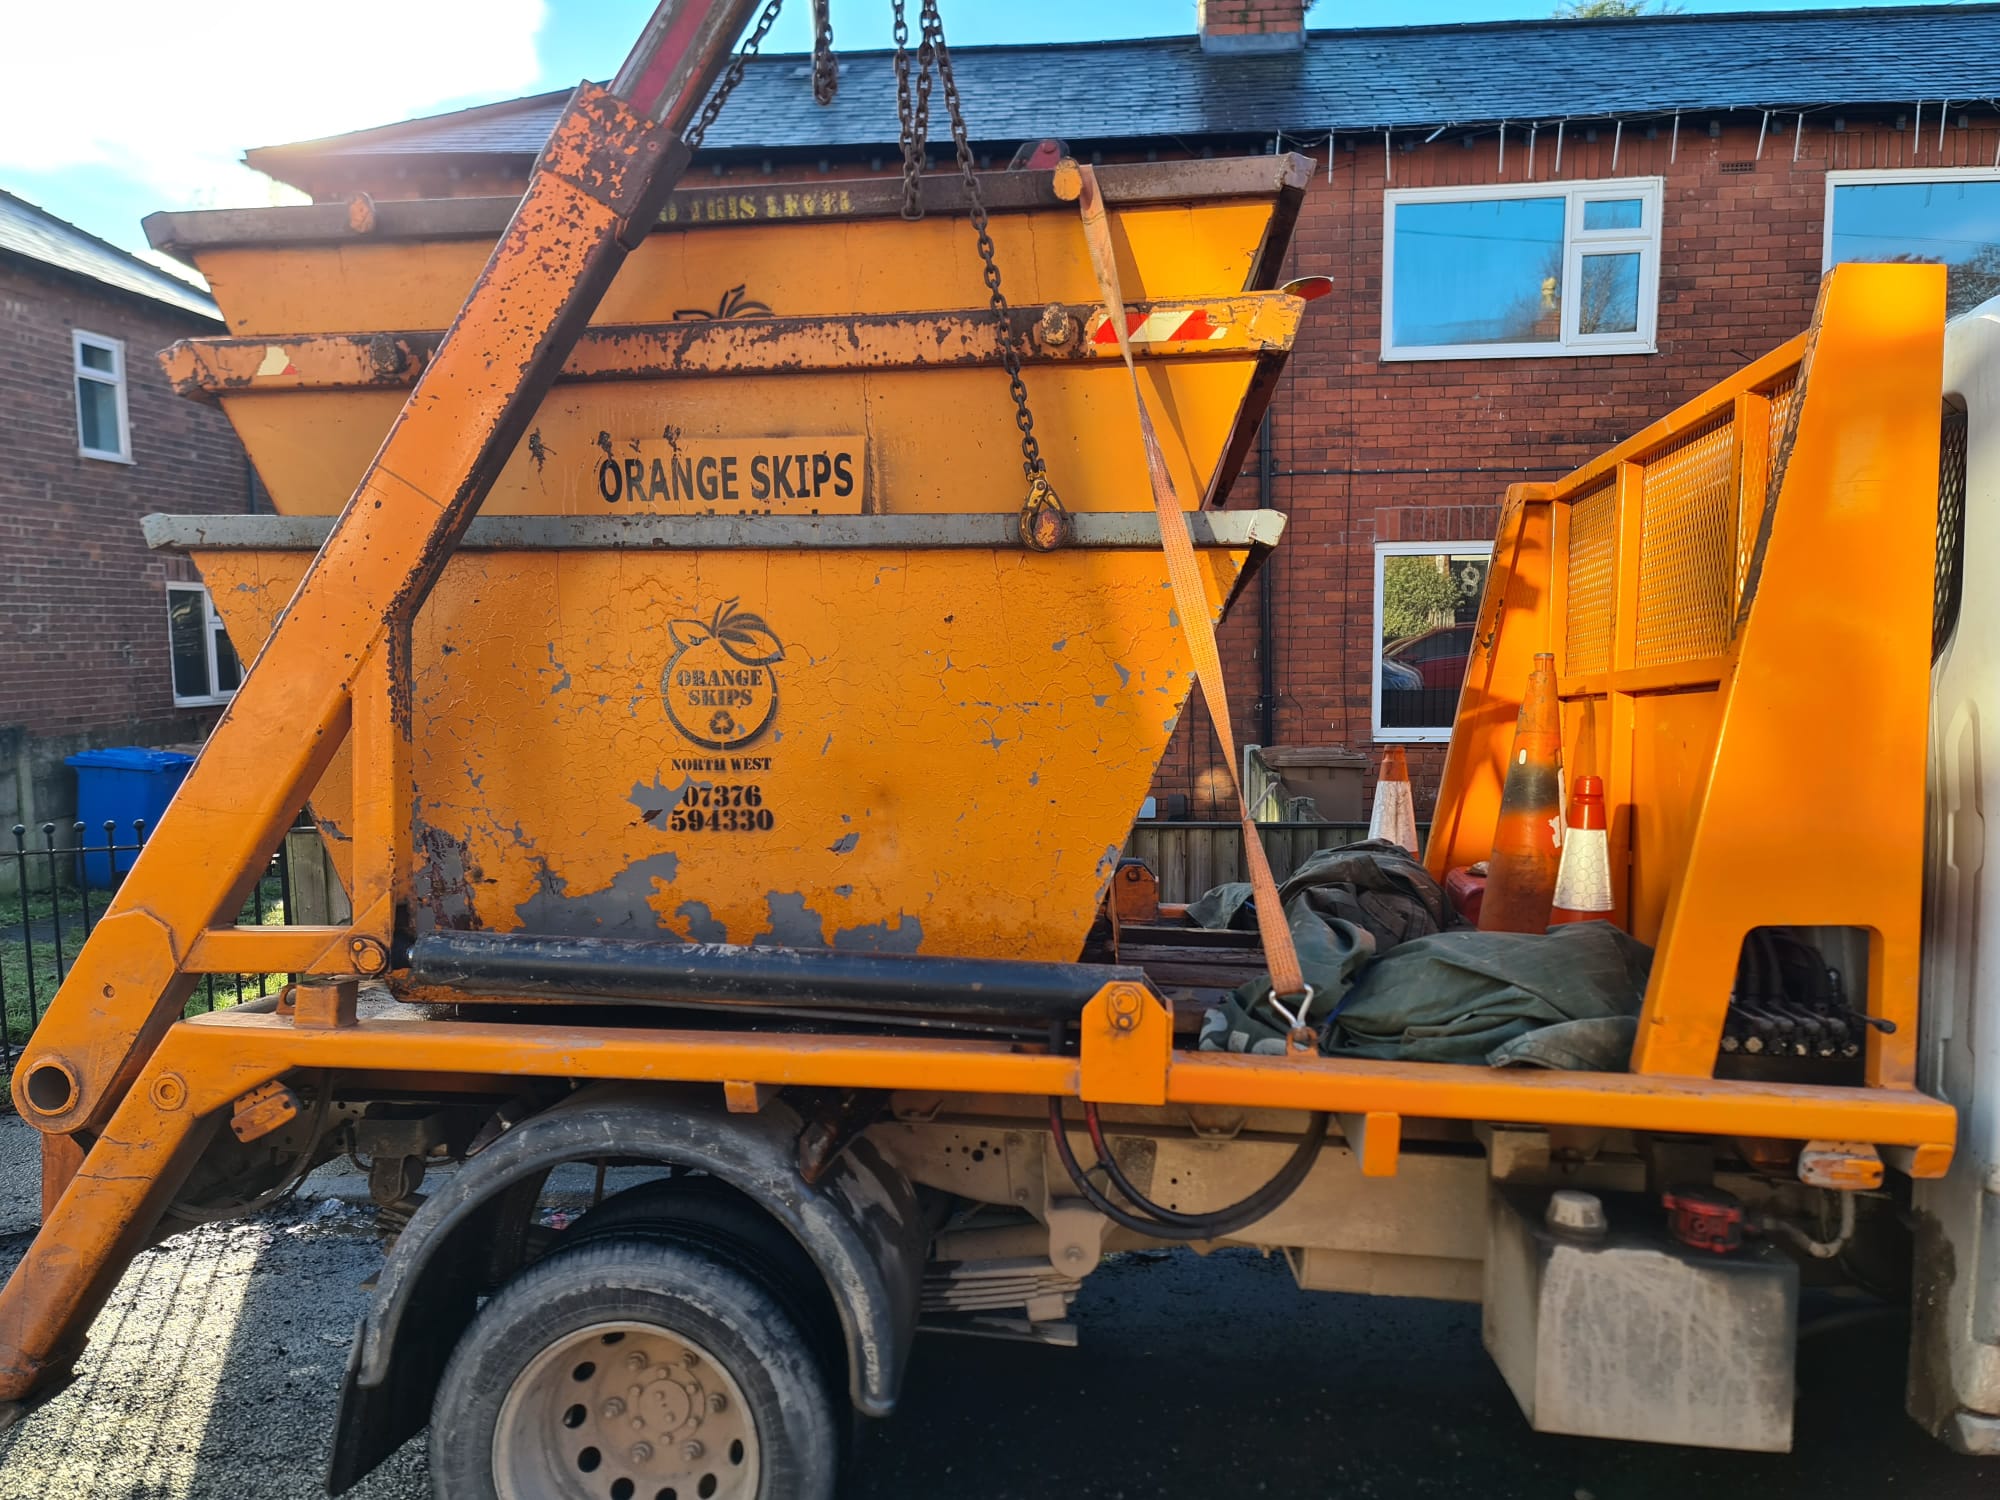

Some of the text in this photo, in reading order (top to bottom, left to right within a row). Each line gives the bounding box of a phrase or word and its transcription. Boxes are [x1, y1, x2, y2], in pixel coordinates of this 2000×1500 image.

[600, 452, 854, 503] ORANGE SKIPS
[677, 669, 763, 687] ORANGE
[688, 689, 753, 706] SKIPS
[671, 757, 772, 771] NORTH WEST
[682, 785, 762, 808] 07376
[671, 808, 774, 832] 594330
